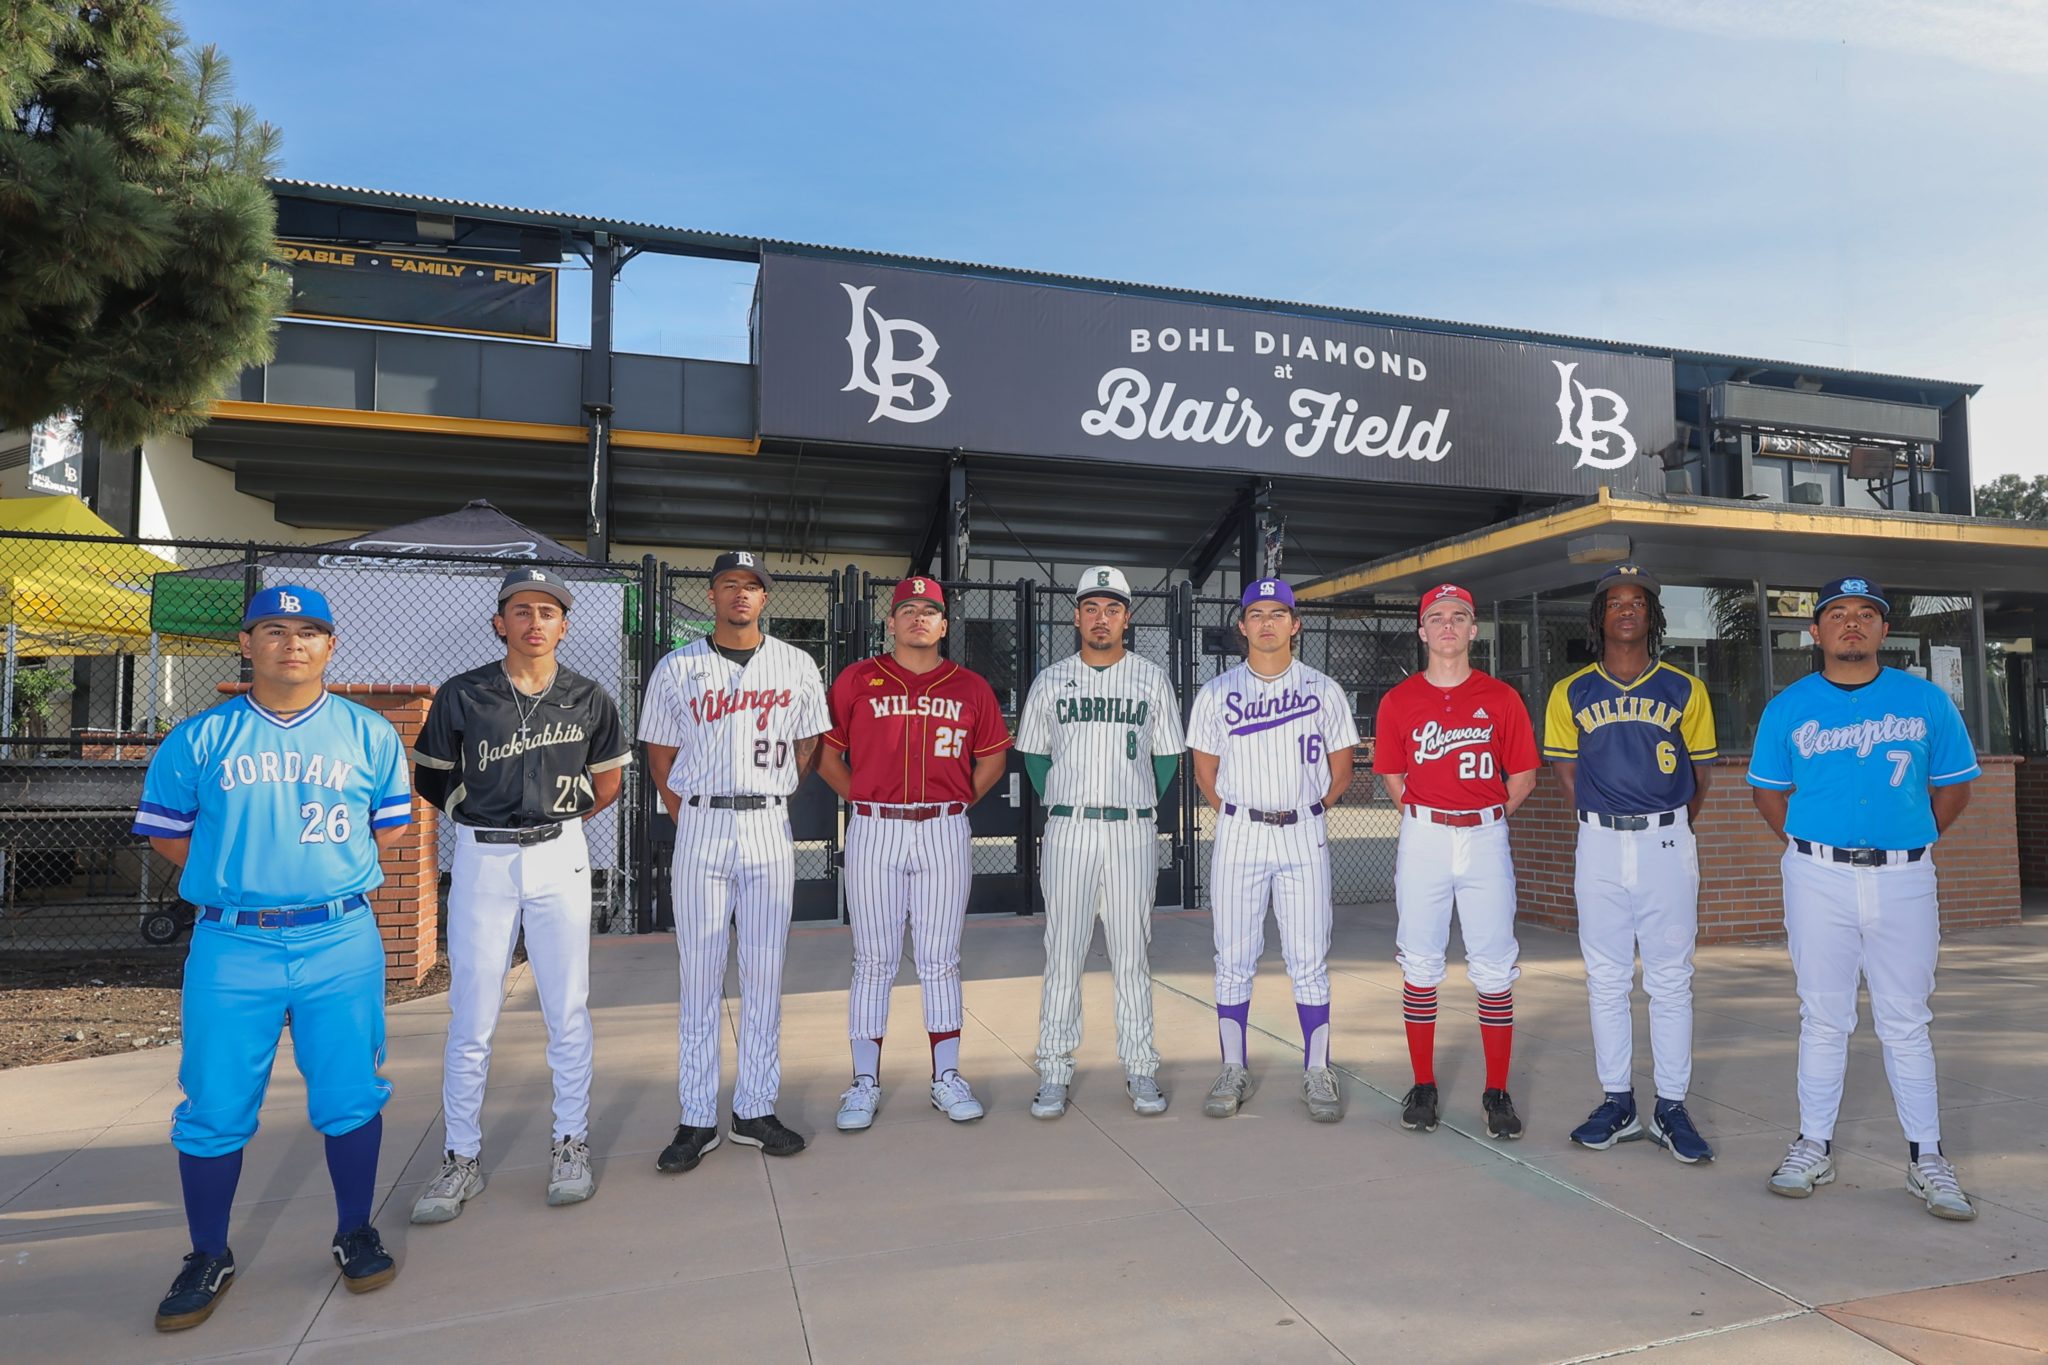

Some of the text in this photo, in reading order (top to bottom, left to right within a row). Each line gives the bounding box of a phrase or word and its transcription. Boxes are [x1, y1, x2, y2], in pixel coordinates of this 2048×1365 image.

[391, 258, 465, 277] FAMILY
[494, 269, 536, 285] FUN
[840, 283, 952, 423] LB
[1130, 327, 1427, 381] BOHL DIAMOND
[1274, 363, 1293, 379] at
[1081, 367, 1452, 462] Blair Field
[1551, 360, 1638, 470] LB
[279, 591, 302, 613] LB
[689, 687, 792, 731] Vikings
[869, 695, 963, 722] WILSON
[1055, 697, 1149, 727] CABRILLO
[1224, 688, 1321, 737] Saints
[1575, 697, 1683, 734] MILLIKAN
[478, 722, 585, 772] Jackrabbits
[753, 738, 788, 769] 20
[933, 726, 968, 760] 25
[1126, 731, 1138, 761] 8
[1298, 734, 1322, 765] 16
[1412, 720, 1494, 765] Lakewood
[1792, 713, 1928, 759] Compton
[219, 751, 352, 793] JORDAN
[1458, 751, 1495, 780] 20
[1656, 740, 1677, 775] 6
[1887, 750, 1912, 787] 7
[300, 802, 351, 845] 26
